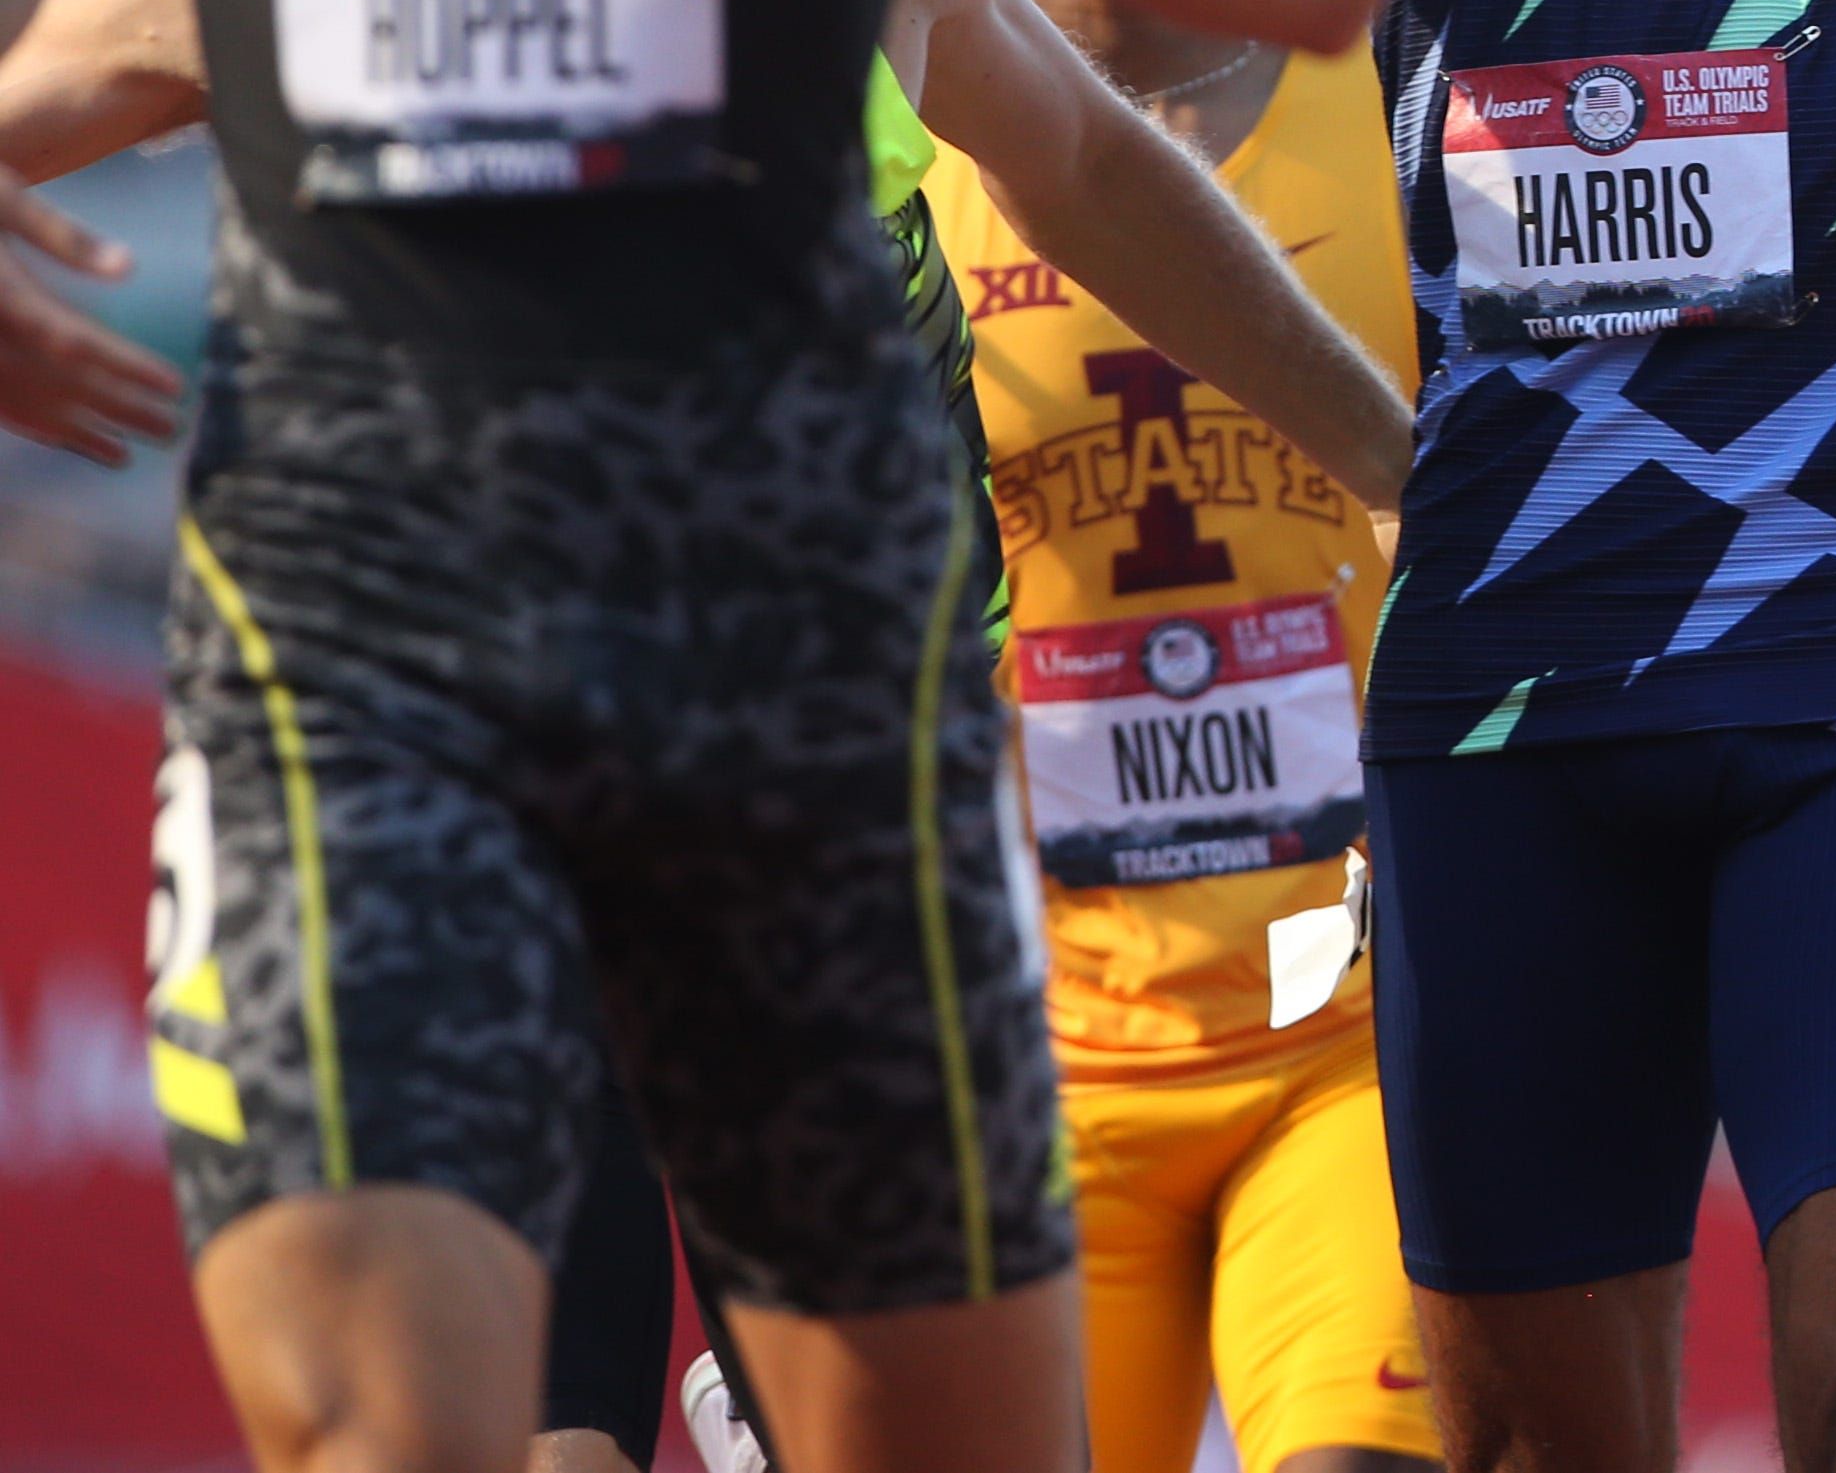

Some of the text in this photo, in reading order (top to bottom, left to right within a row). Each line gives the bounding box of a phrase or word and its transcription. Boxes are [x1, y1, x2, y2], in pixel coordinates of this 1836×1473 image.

[1491, 97, 1552, 120] USATF
[1662, 64, 1769, 93] U.S. OLYMPIC
[1662, 89, 1769, 118] TEAM TRIALS
[1514, 162, 1713, 269] HARRIS
[968, 262, 1072, 322] XII
[990, 408, 1345, 567] STATE
[1111, 705, 1278, 805] NIXON
